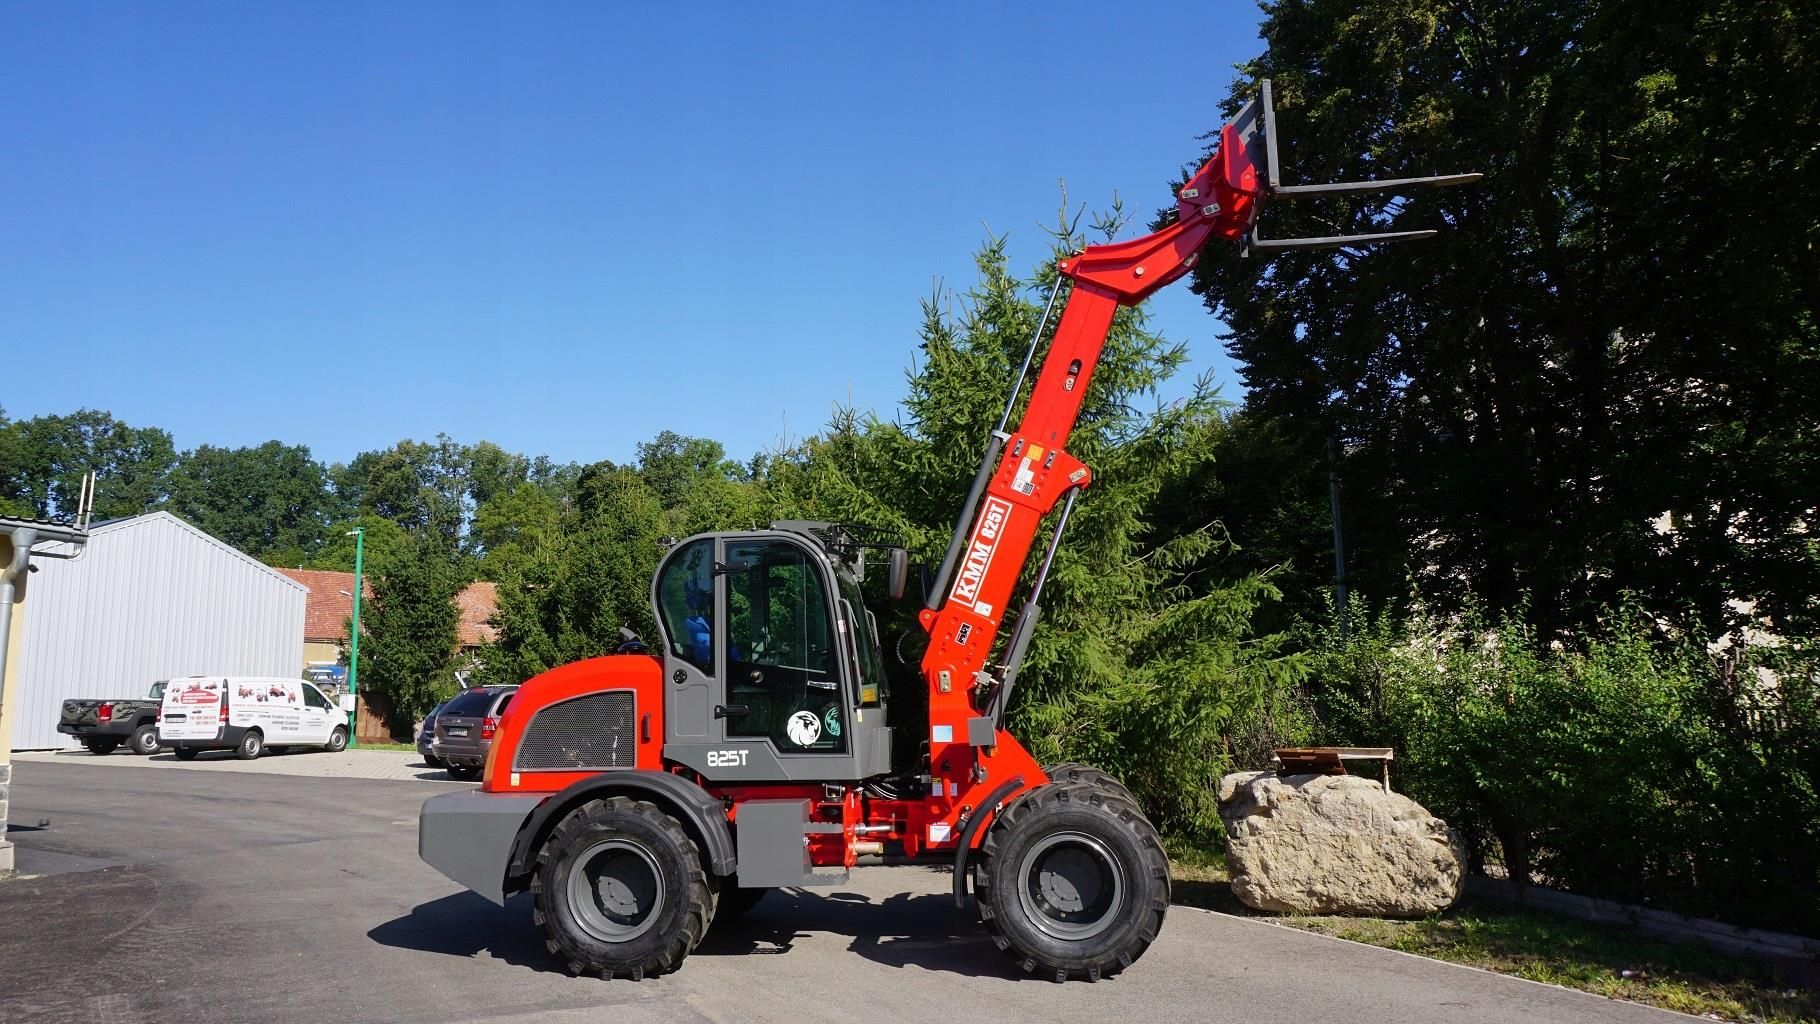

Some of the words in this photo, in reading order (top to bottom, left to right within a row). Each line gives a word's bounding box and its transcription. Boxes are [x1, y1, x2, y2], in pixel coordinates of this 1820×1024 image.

[956, 540, 993, 600] KMM
[980, 503, 1005, 539] 825T
[707, 750, 749, 766] 825T
